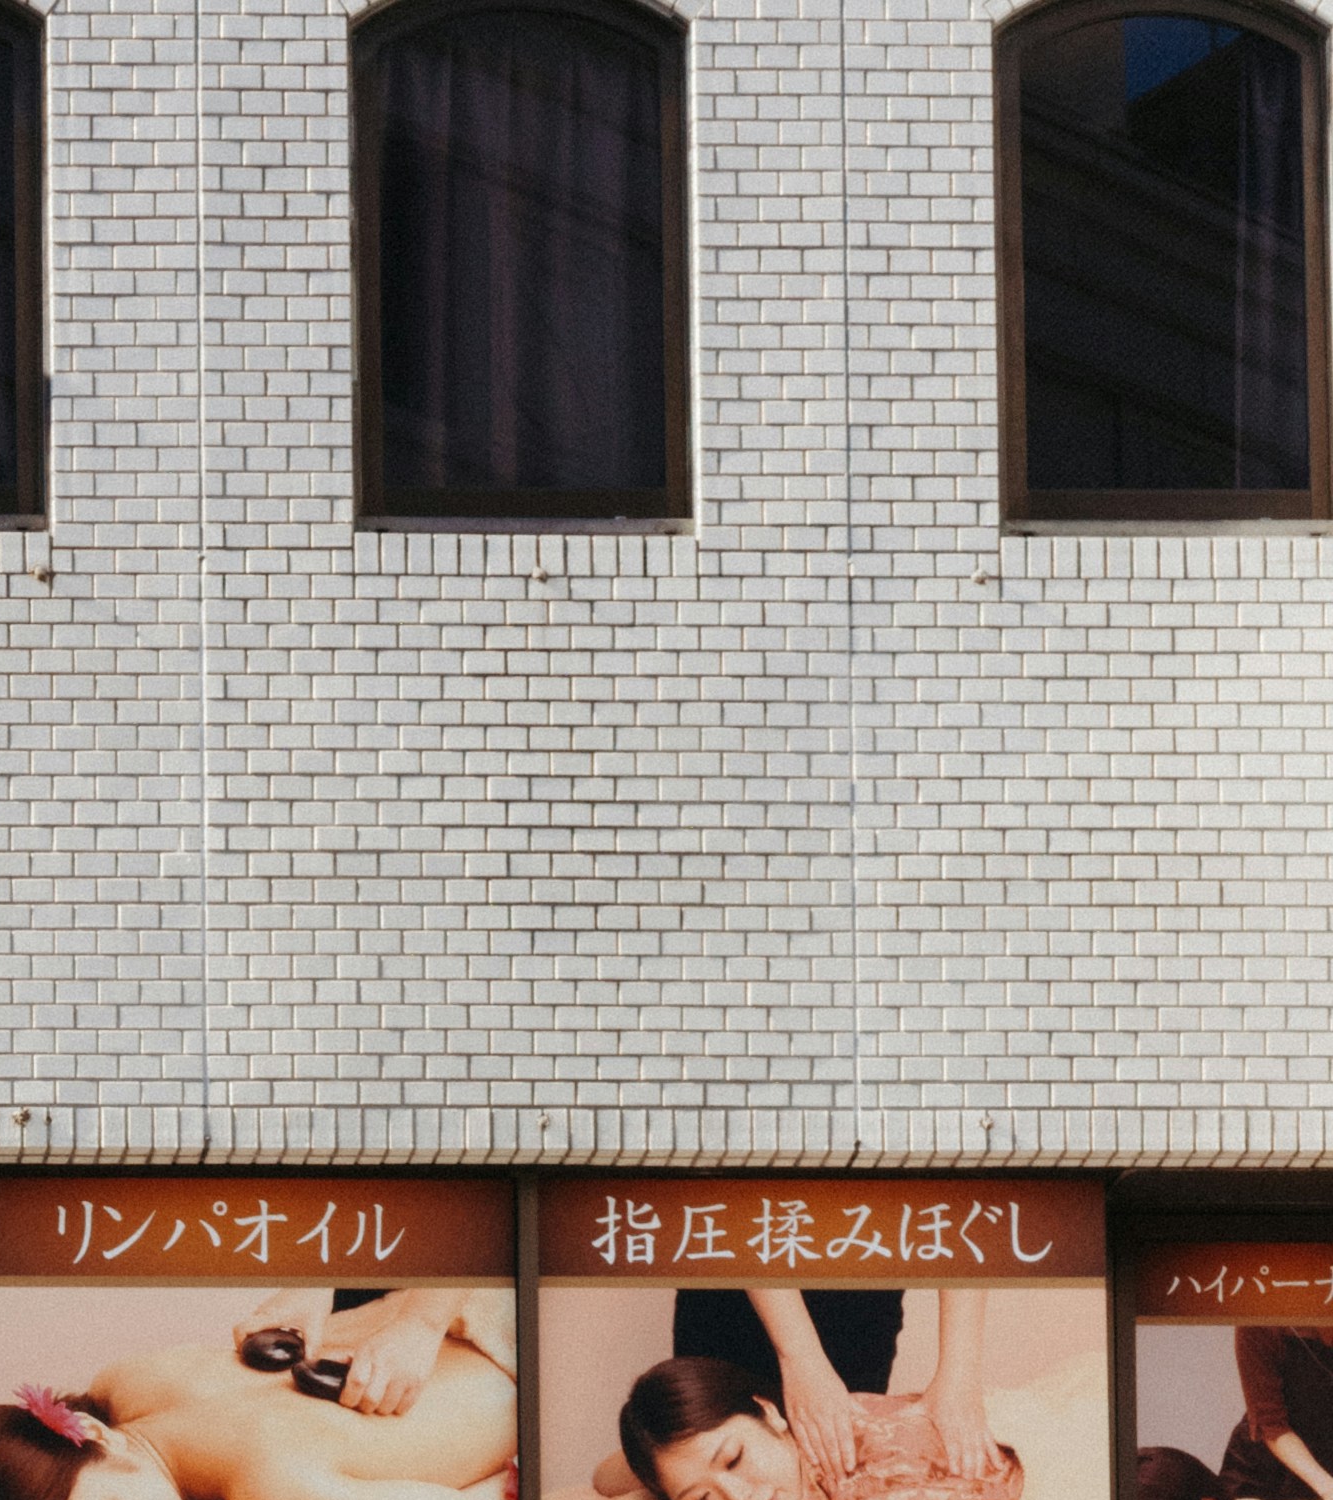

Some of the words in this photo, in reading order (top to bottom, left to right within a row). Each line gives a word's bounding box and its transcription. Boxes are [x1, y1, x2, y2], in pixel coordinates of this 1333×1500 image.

[57, 1199, 405, 1264] リンパオイル
[591, 1195, 1053, 1268] 指圧揉みほぐし
